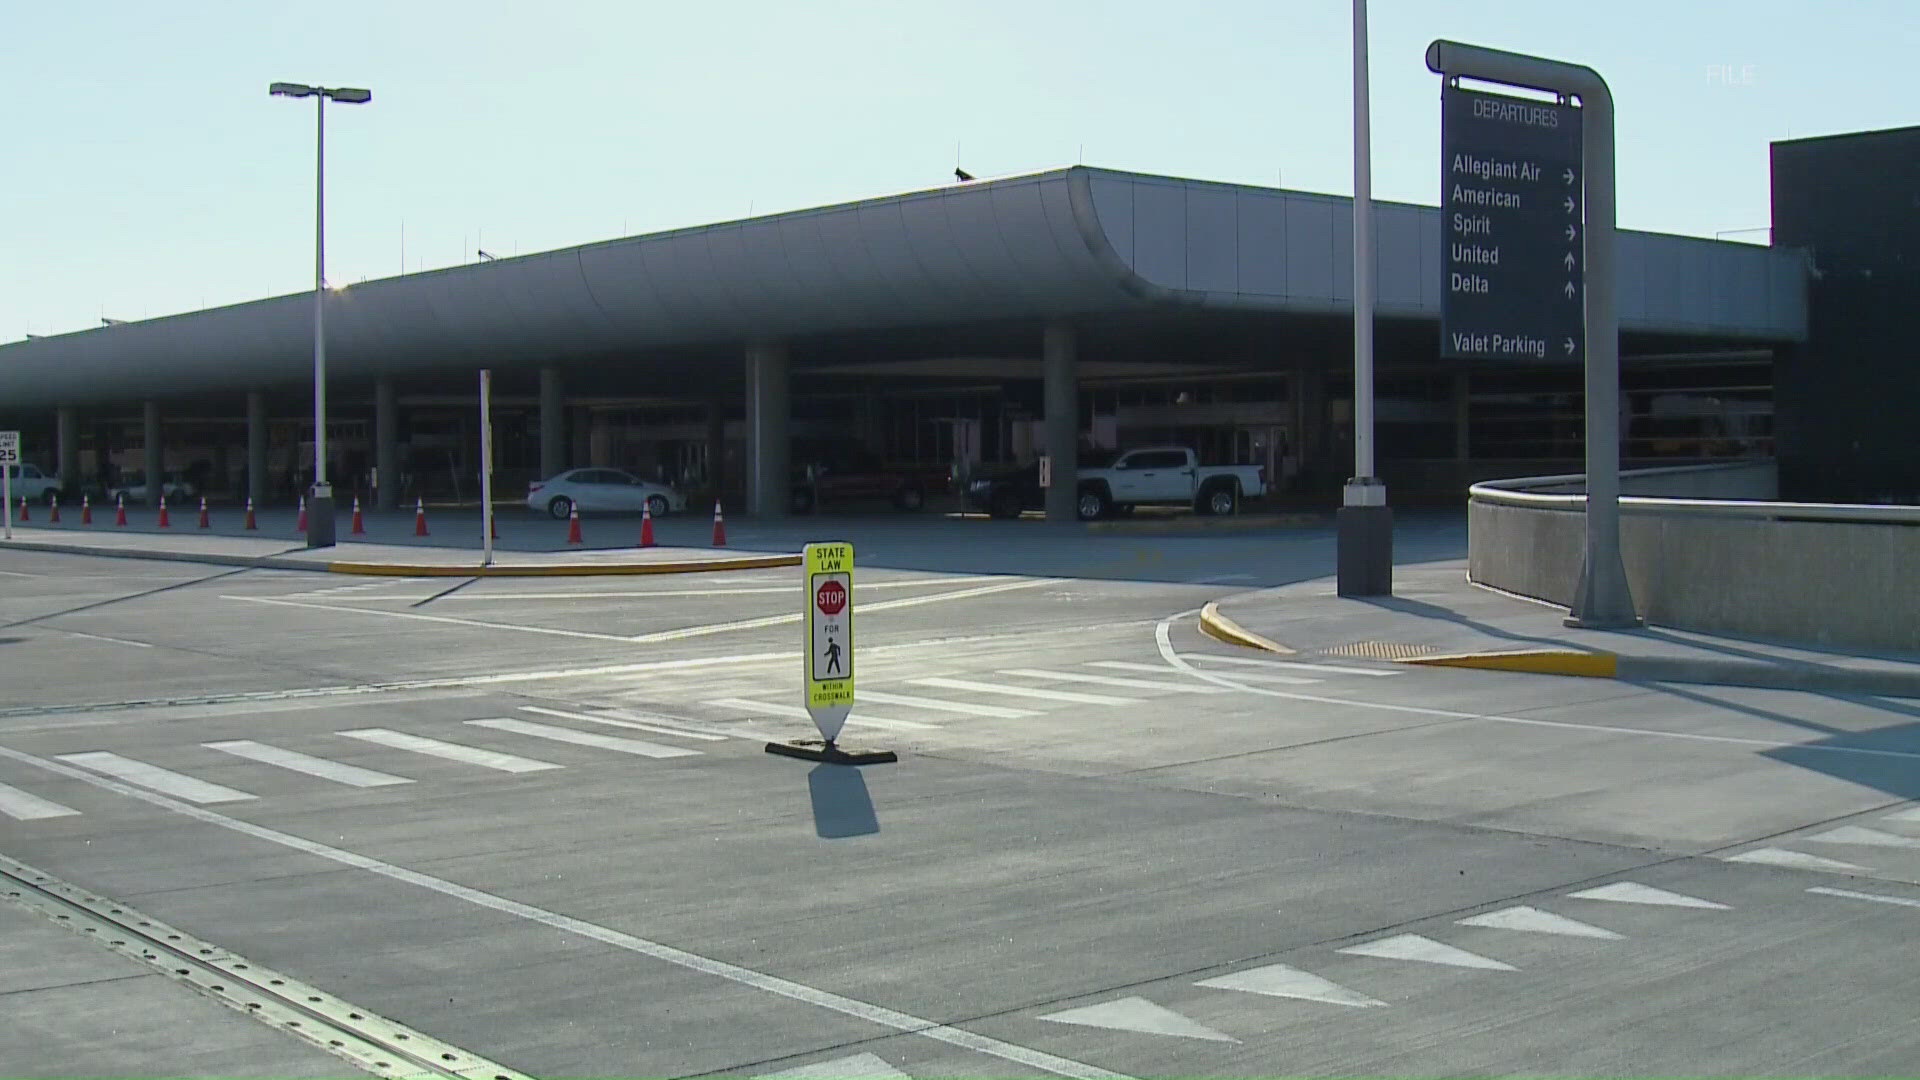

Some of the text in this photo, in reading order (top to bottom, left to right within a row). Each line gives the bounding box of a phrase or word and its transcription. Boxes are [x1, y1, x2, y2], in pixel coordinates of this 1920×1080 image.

[1474, 99, 1558, 128] DEPARTURES
[1453, 154, 1541, 182] Allegiant Air
[1452, 184, 1520, 209] American
[1454, 213, 1491, 236] Spirit
[1452, 244, 1499, 265] United
[1452, 273, 1489, 294] Delta
[1453, 333, 1545, 358] Valet Parking
[0, 449, 17, 461] 25
[817, 547, 846, 559] STATE
[821, 560, 841, 571] LAW
[818, 591, 845, 605] STOP
[824, 625, 839, 634] FOR
[822, 683, 843, 691] WITHIN
[814, 691, 850, 702] CROSSWALK
